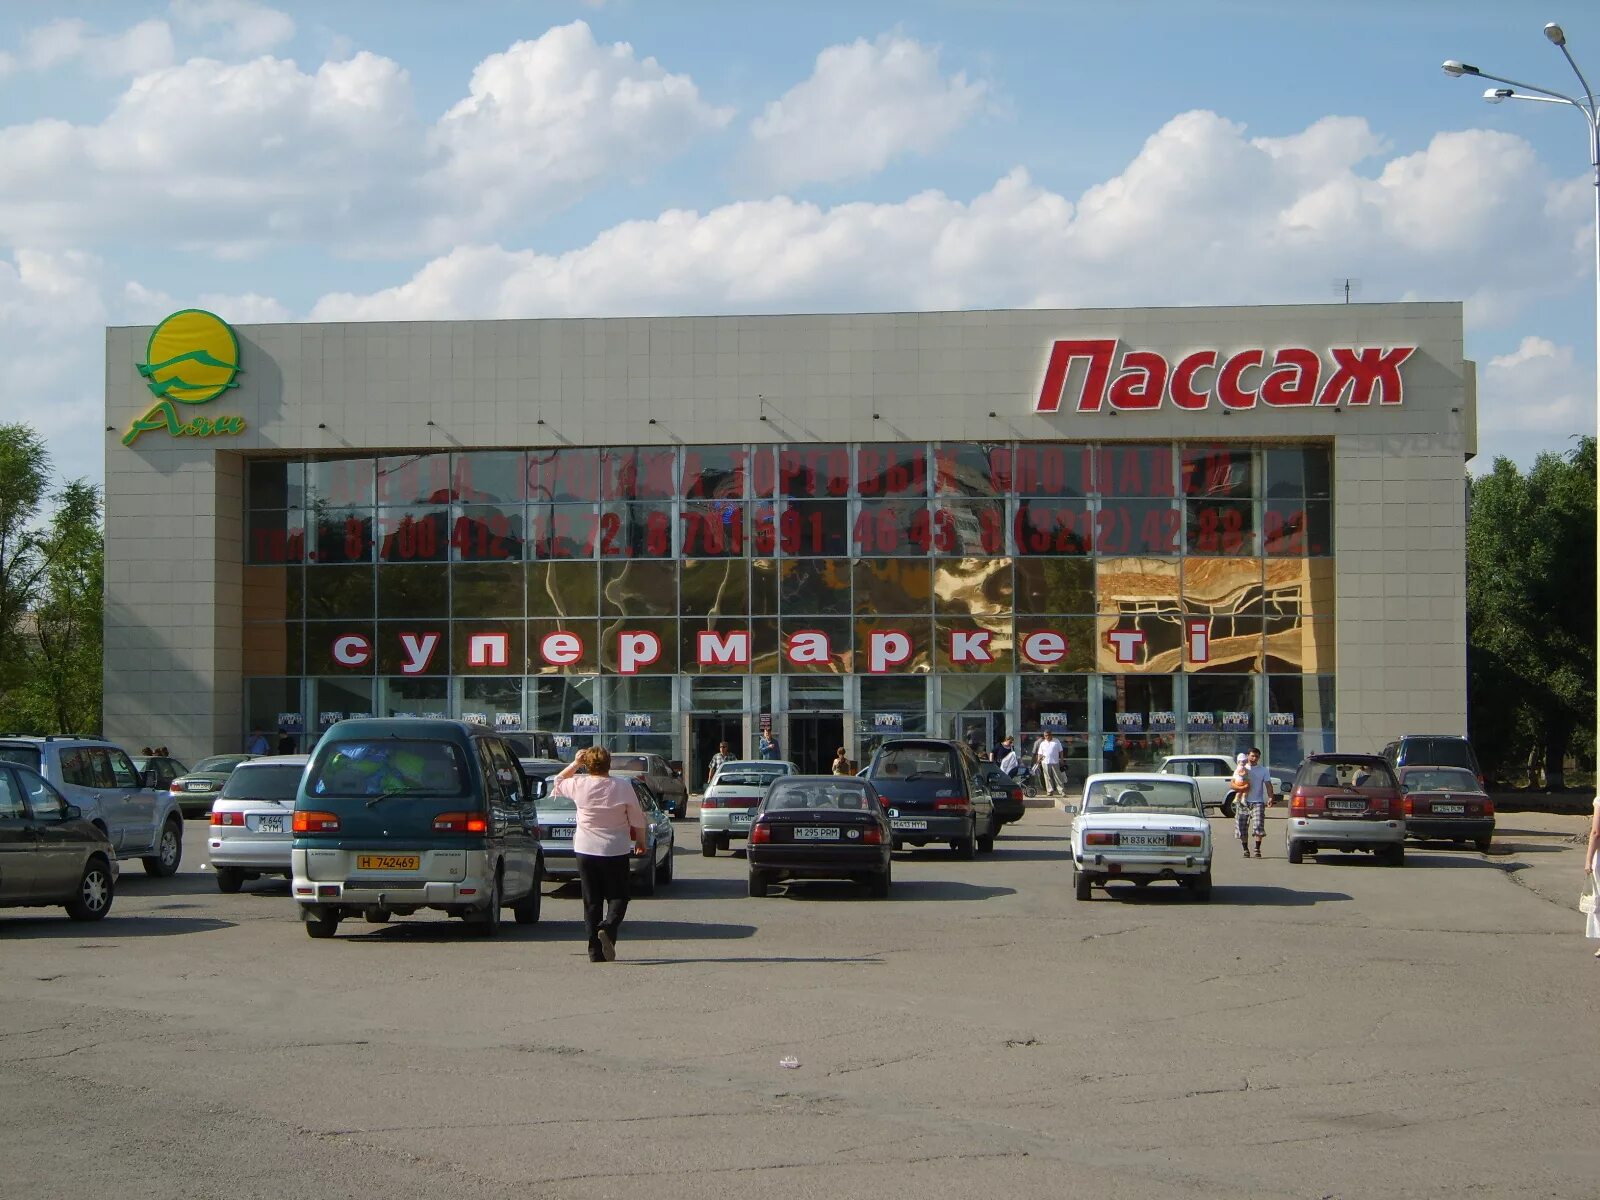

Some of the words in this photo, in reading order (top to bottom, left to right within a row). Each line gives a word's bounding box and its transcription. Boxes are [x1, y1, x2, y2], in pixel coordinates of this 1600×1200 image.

[1036, 339, 1418, 413] Пассаж
[268, 816, 282, 825] 644
[804, 828, 819, 837] 295
[362, 858, 370, 868] H
[376, 857, 415, 869] 742469
